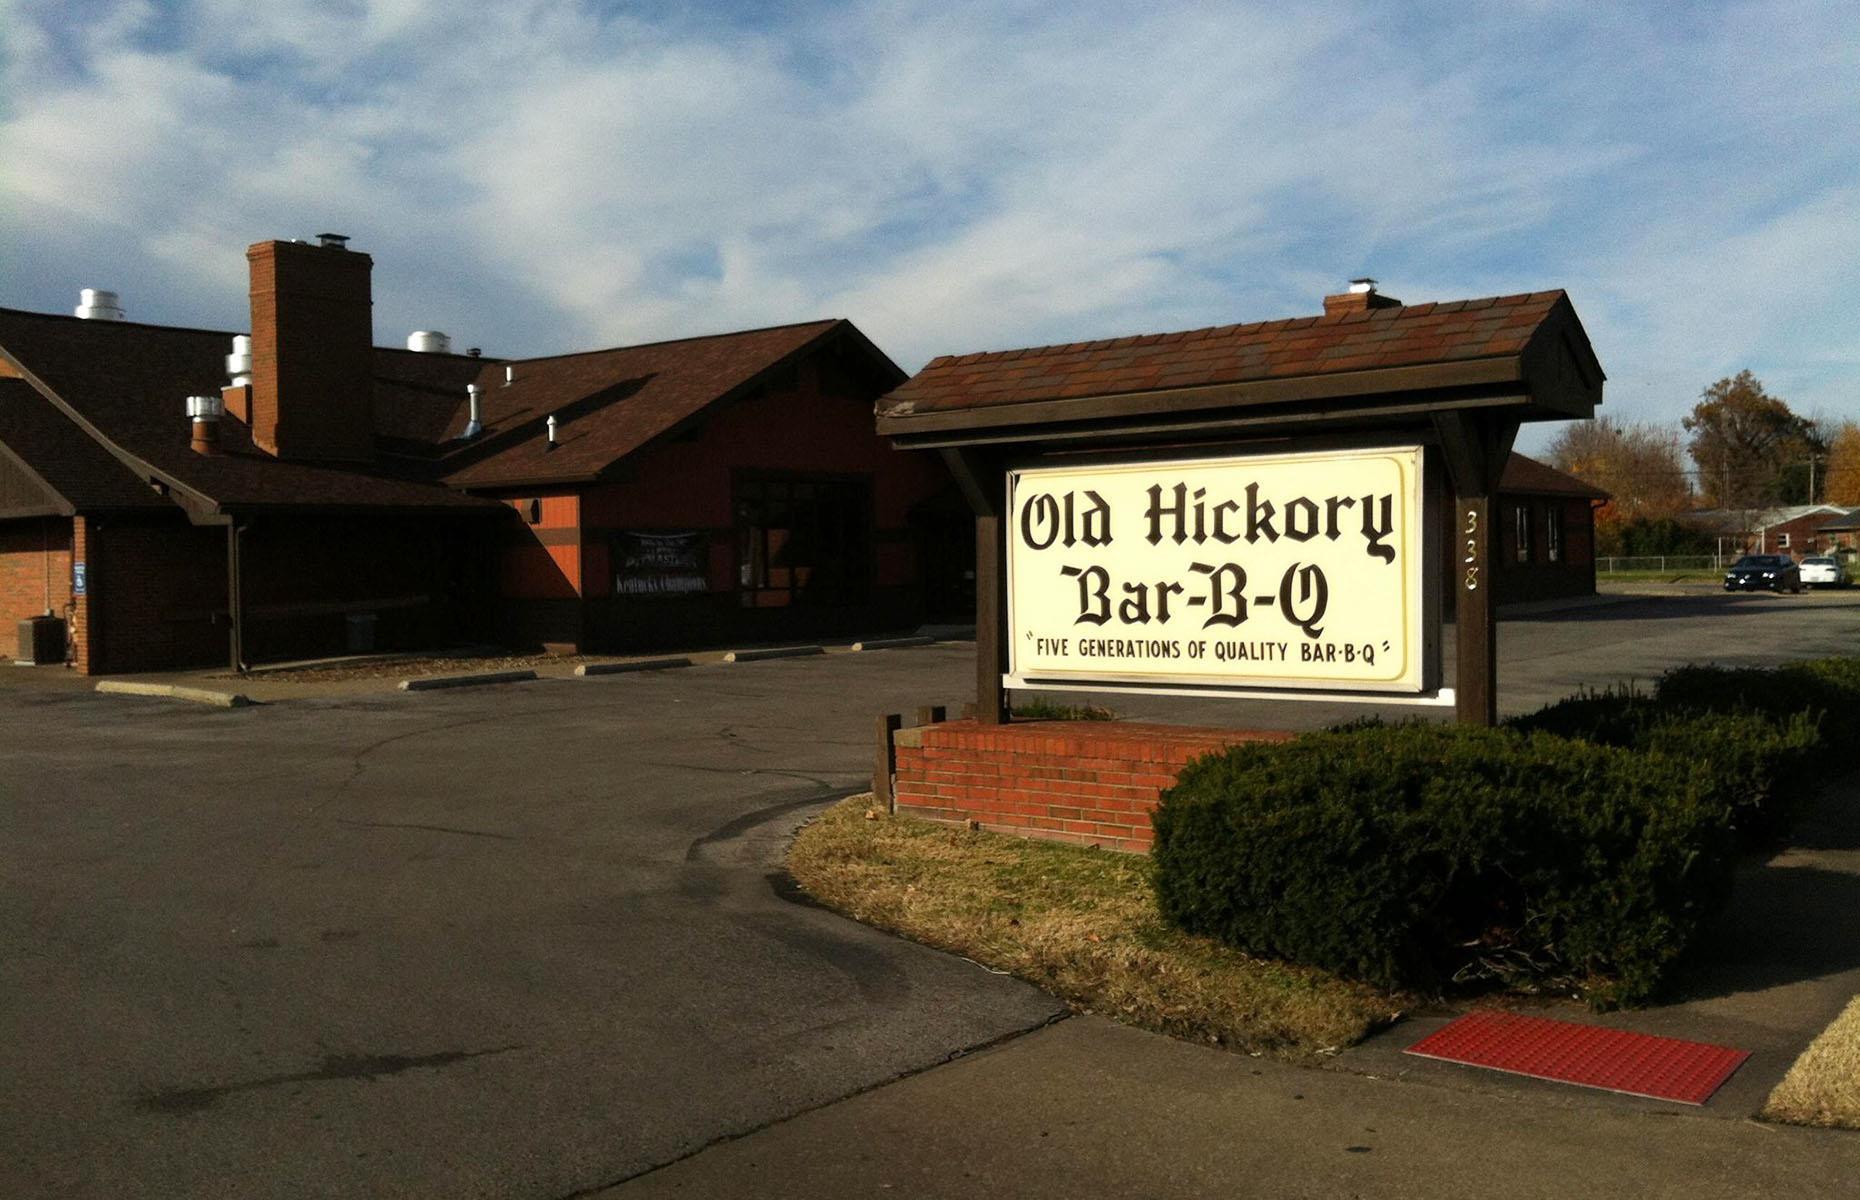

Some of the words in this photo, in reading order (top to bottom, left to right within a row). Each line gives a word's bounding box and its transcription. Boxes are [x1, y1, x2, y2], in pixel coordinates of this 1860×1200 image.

[1020, 490, 1114, 551] Old
[1144, 481, 1396, 565] Hickory
[1465, 511, 1479, 590] 338
[1060, 561, 1329, 640] Bar-B-Q
[1078, 638, 1181, 659] GENERATIONS
[1187, 640, 1207, 659] OF
[1214, 641, 1288, 662] QUALITY
